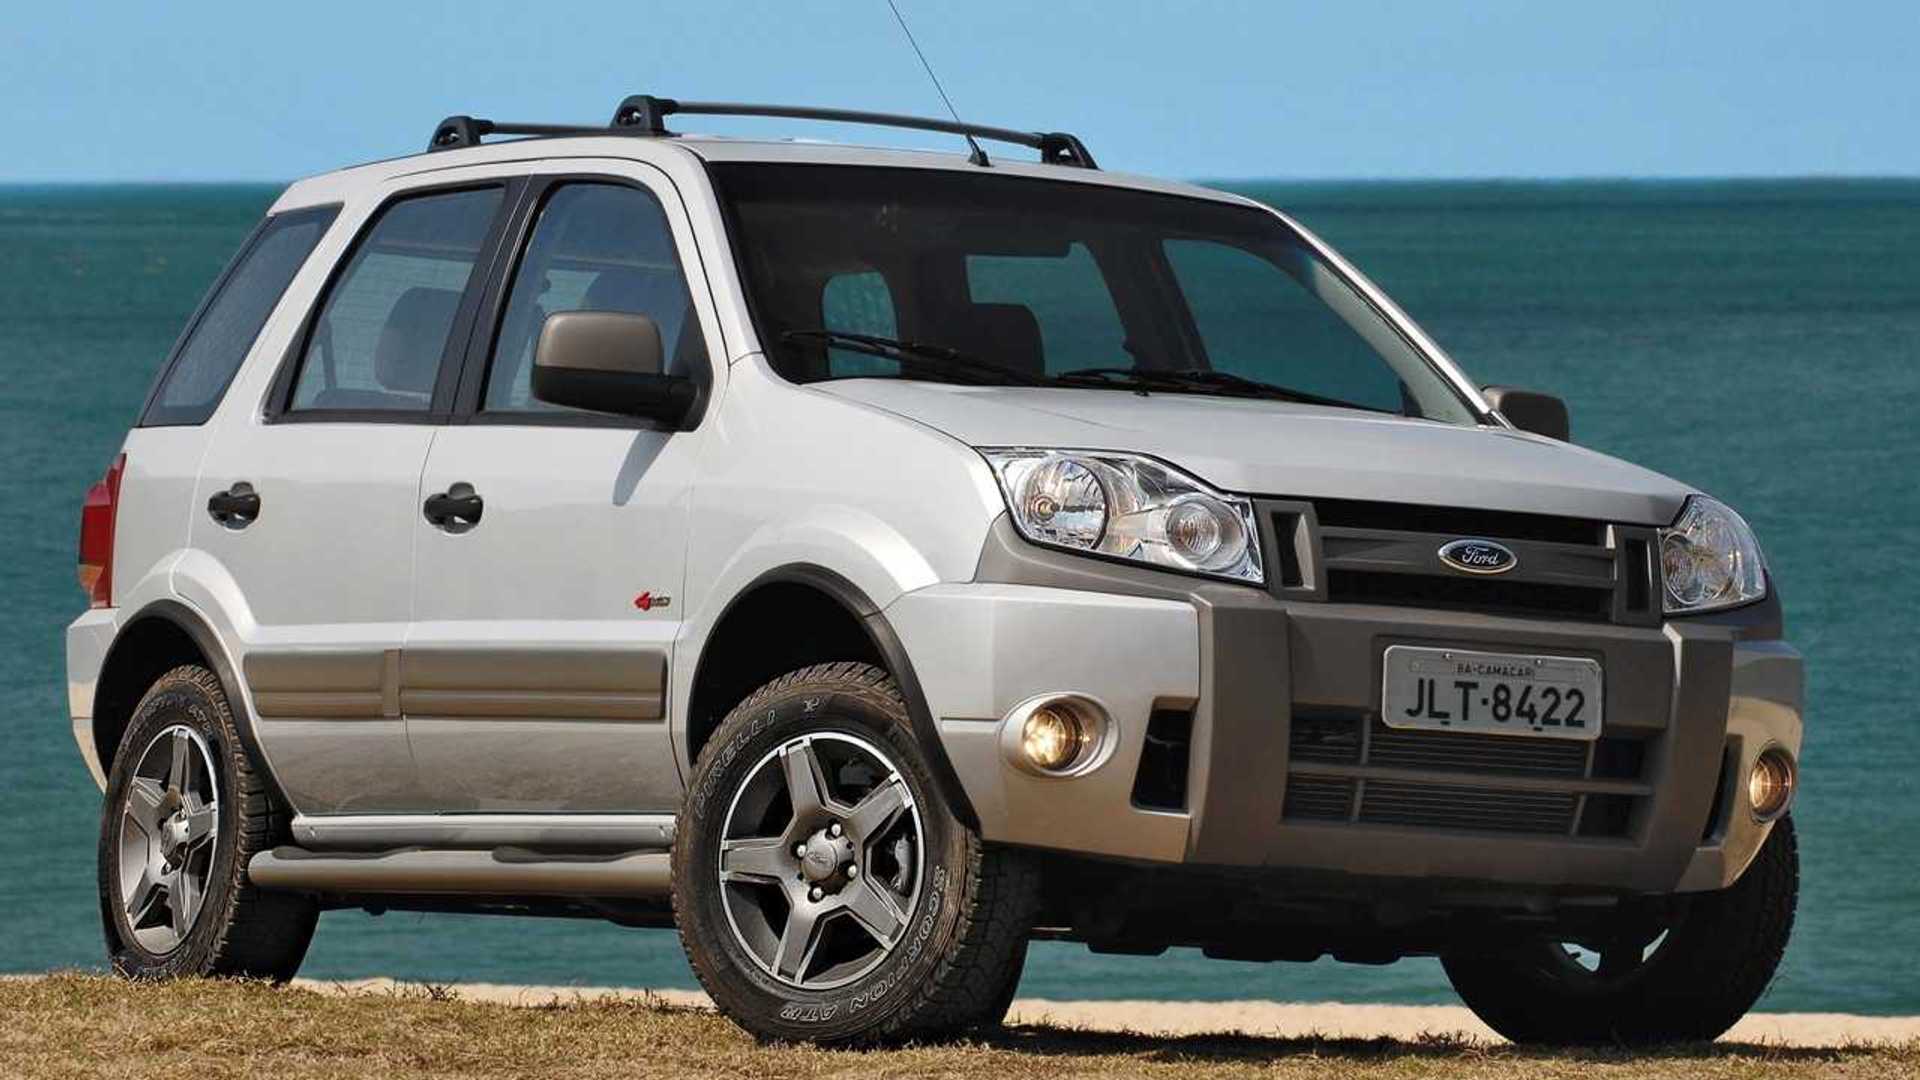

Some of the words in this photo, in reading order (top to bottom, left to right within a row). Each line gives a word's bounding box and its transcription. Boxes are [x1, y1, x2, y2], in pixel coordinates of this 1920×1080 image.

[1461, 544, 1499, 565] Ford
[695, 708, 776, 820] PIRELLI
[849, 864, 946, 1013] SCORPION
